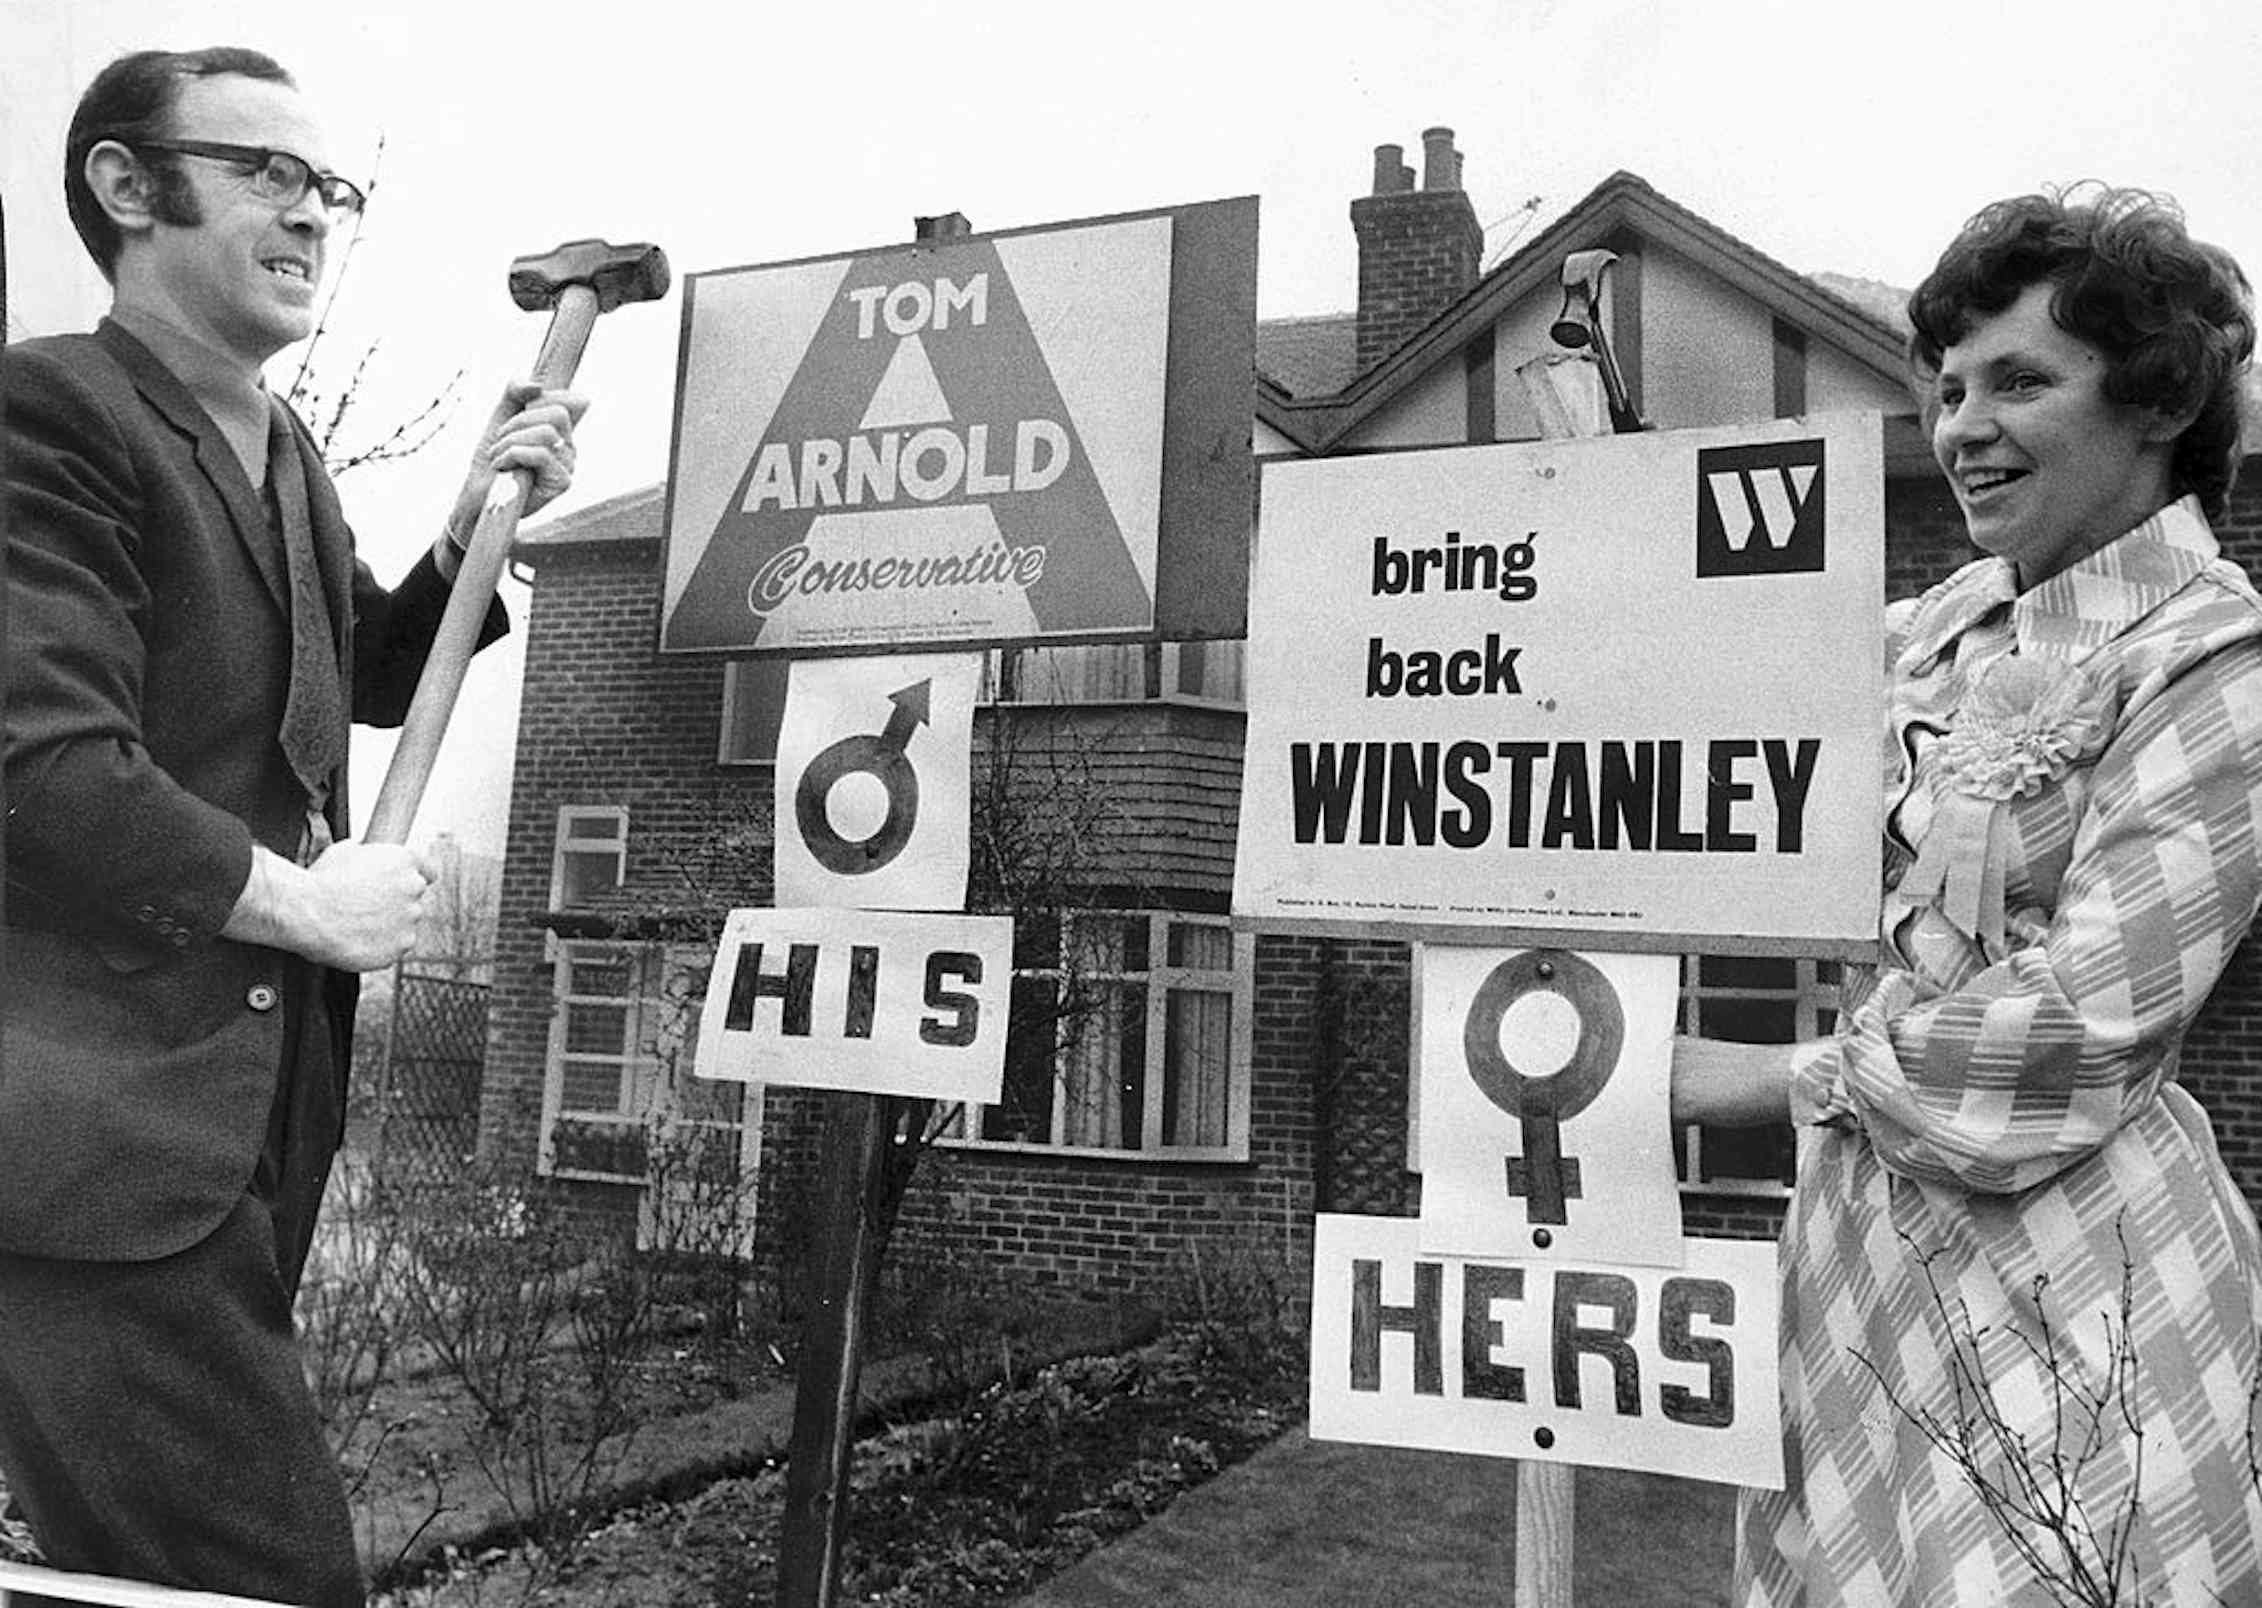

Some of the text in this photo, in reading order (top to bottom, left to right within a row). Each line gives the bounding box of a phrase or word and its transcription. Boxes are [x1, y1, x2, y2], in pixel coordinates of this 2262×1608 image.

[849, 272, 988, 339] TOM
[742, 419, 1070, 513] ARNOLD
[1707, 465, 1818, 551] W
[747, 539, 1047, 617] Conservative
[1371, 531, 1538, 602] bring
[1366, 633, 1523, 697] back
[1290, 738, 1822, 854] WINSTANLEY
[724, 942, 984, 1048] HIS
[1349, 1258, 1736, 1429] HERS
